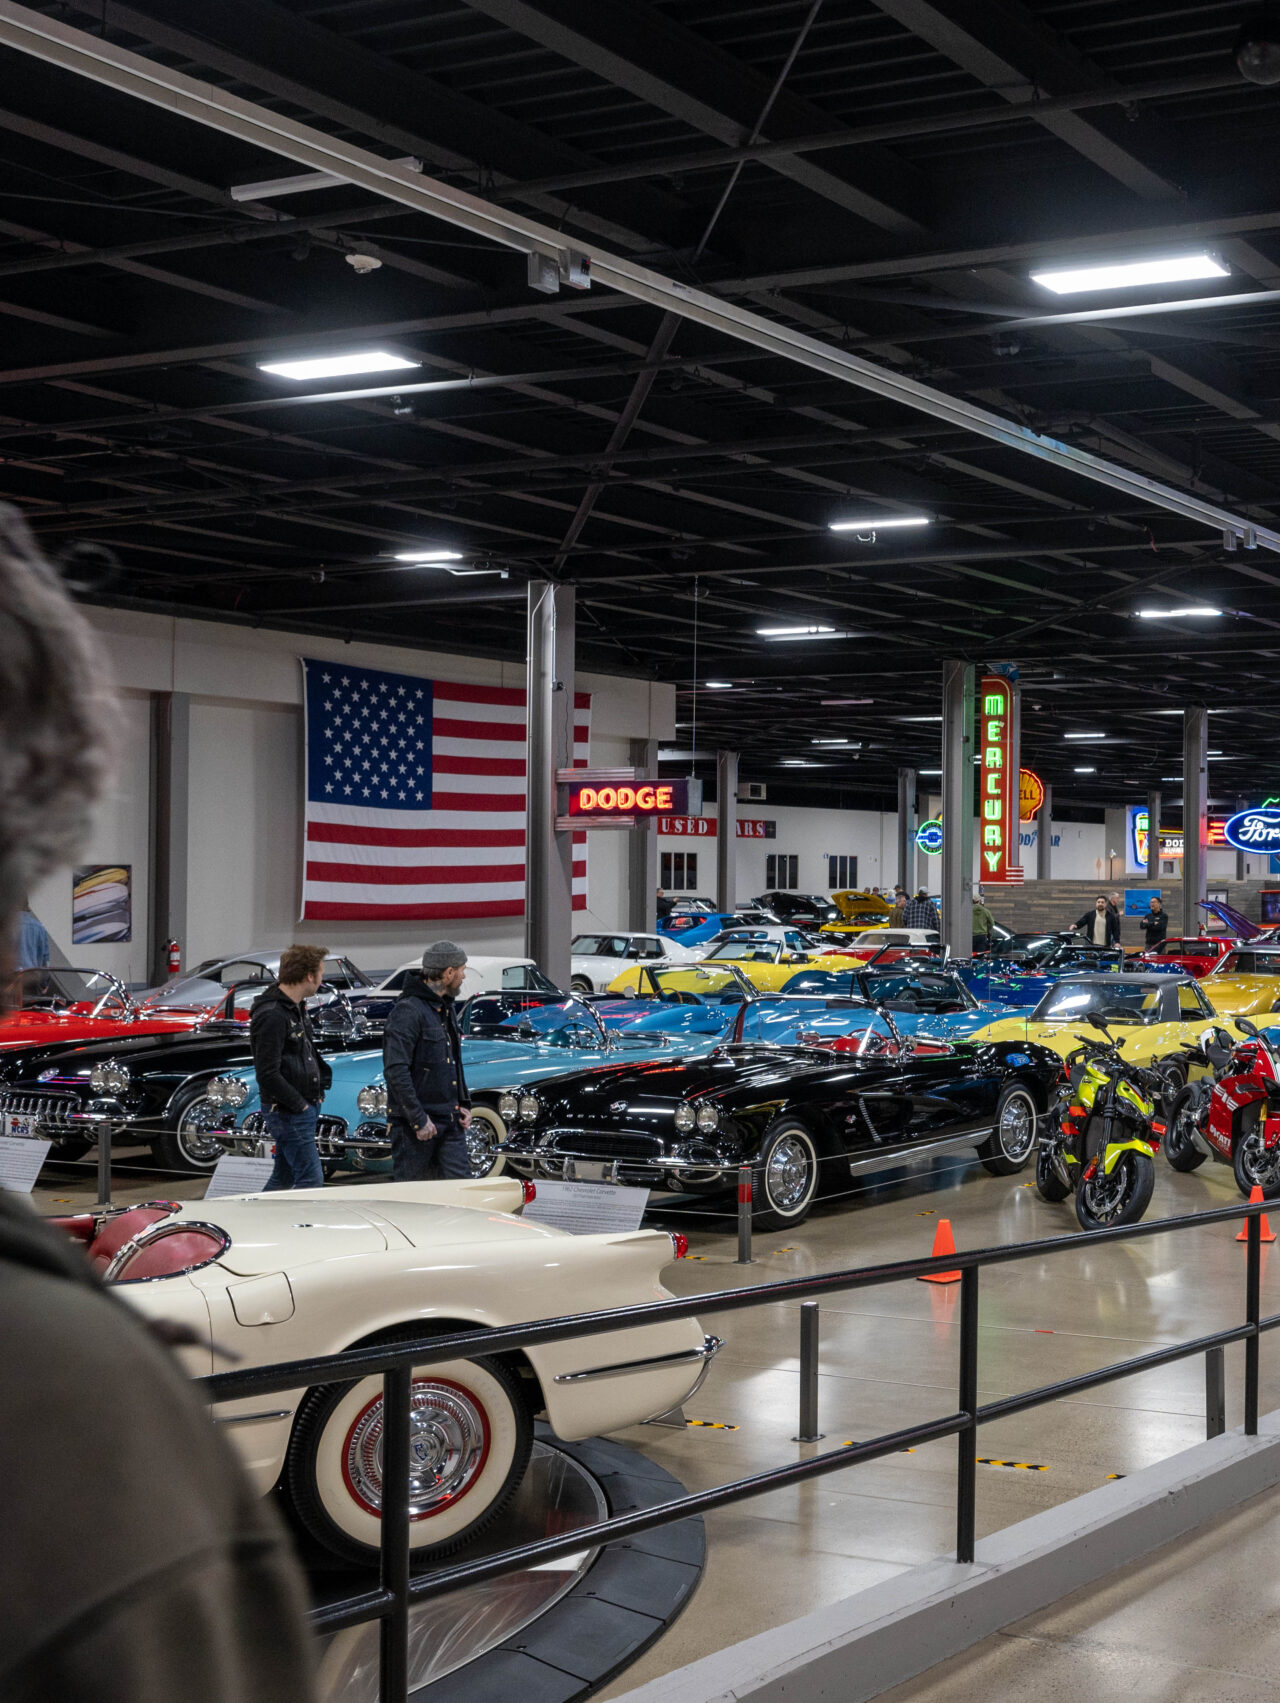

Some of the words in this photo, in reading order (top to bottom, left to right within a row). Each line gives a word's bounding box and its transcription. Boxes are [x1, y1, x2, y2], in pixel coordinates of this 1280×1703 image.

[984, 694, 1004, 872] MERCURY
[579, 786, 674, 810] DODGE
[1019, 789, 1036, 801] ELL
[661, 818, 708, 835] USED
